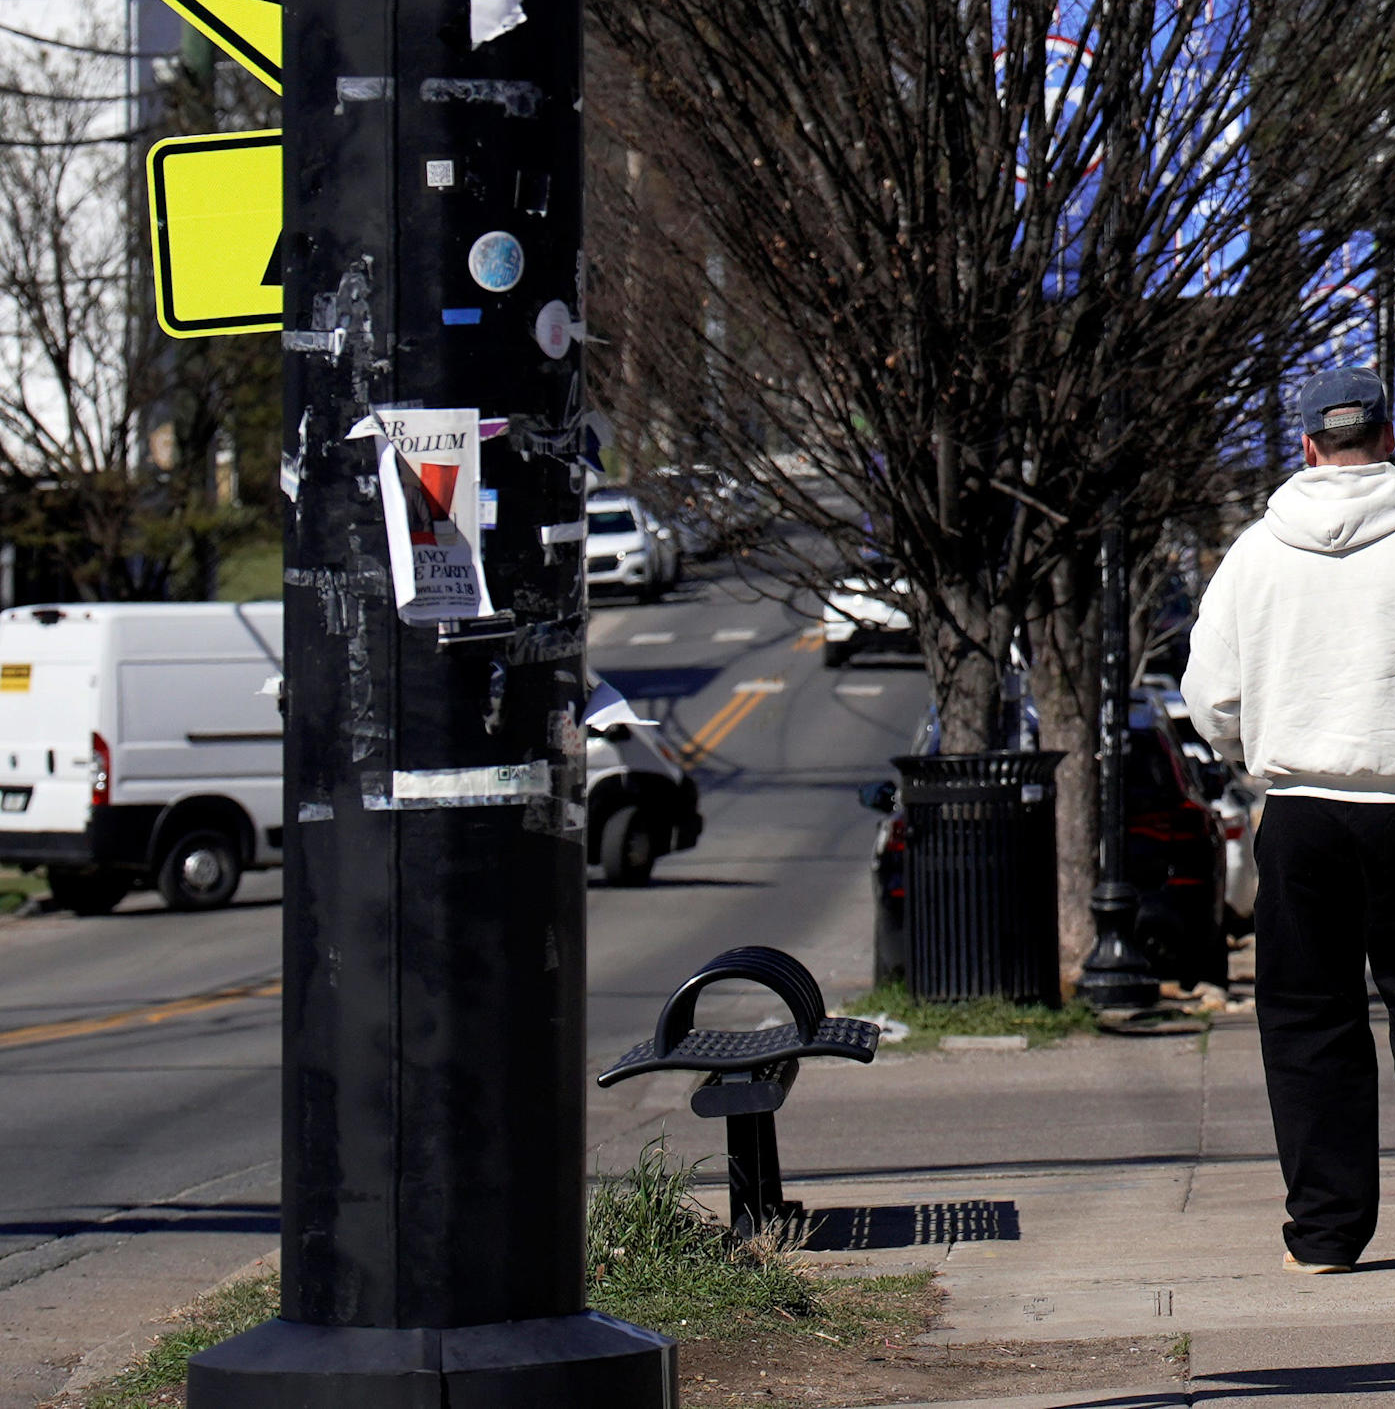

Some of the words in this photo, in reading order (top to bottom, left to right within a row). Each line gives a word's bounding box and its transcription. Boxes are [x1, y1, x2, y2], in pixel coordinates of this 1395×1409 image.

[391, 432, 467, 454] COLLUM
[415, 550, 449, 564] ANCY
[430, 564, 472, 579] PARTY
